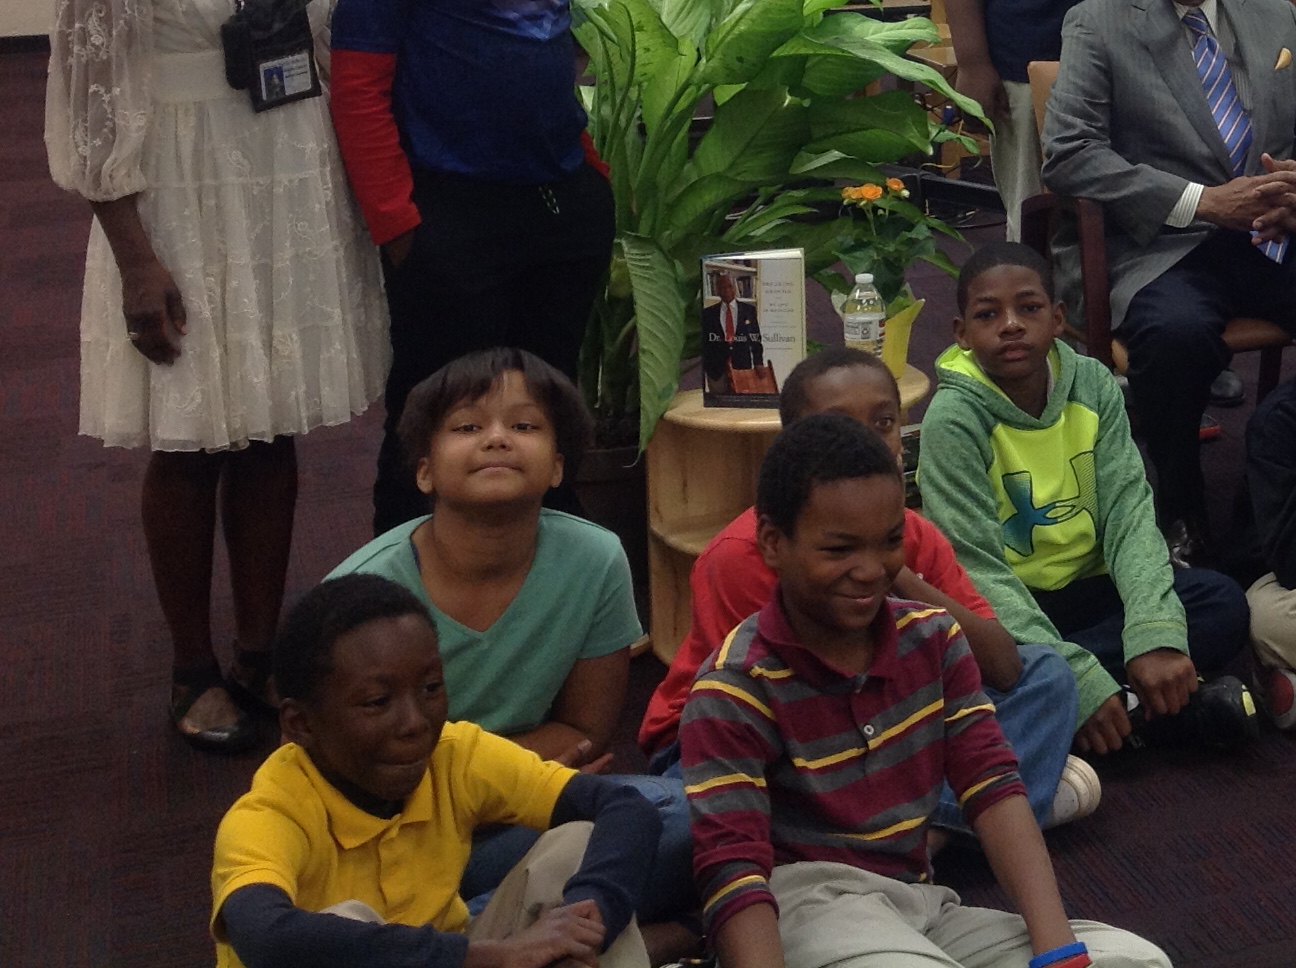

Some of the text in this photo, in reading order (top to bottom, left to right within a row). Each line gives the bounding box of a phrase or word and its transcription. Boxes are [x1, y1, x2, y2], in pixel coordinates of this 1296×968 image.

[709, 332, 721, 342] Dr.
[749, 332, 762, 343] W.
[762, 333, 796, 343] Sullivan
